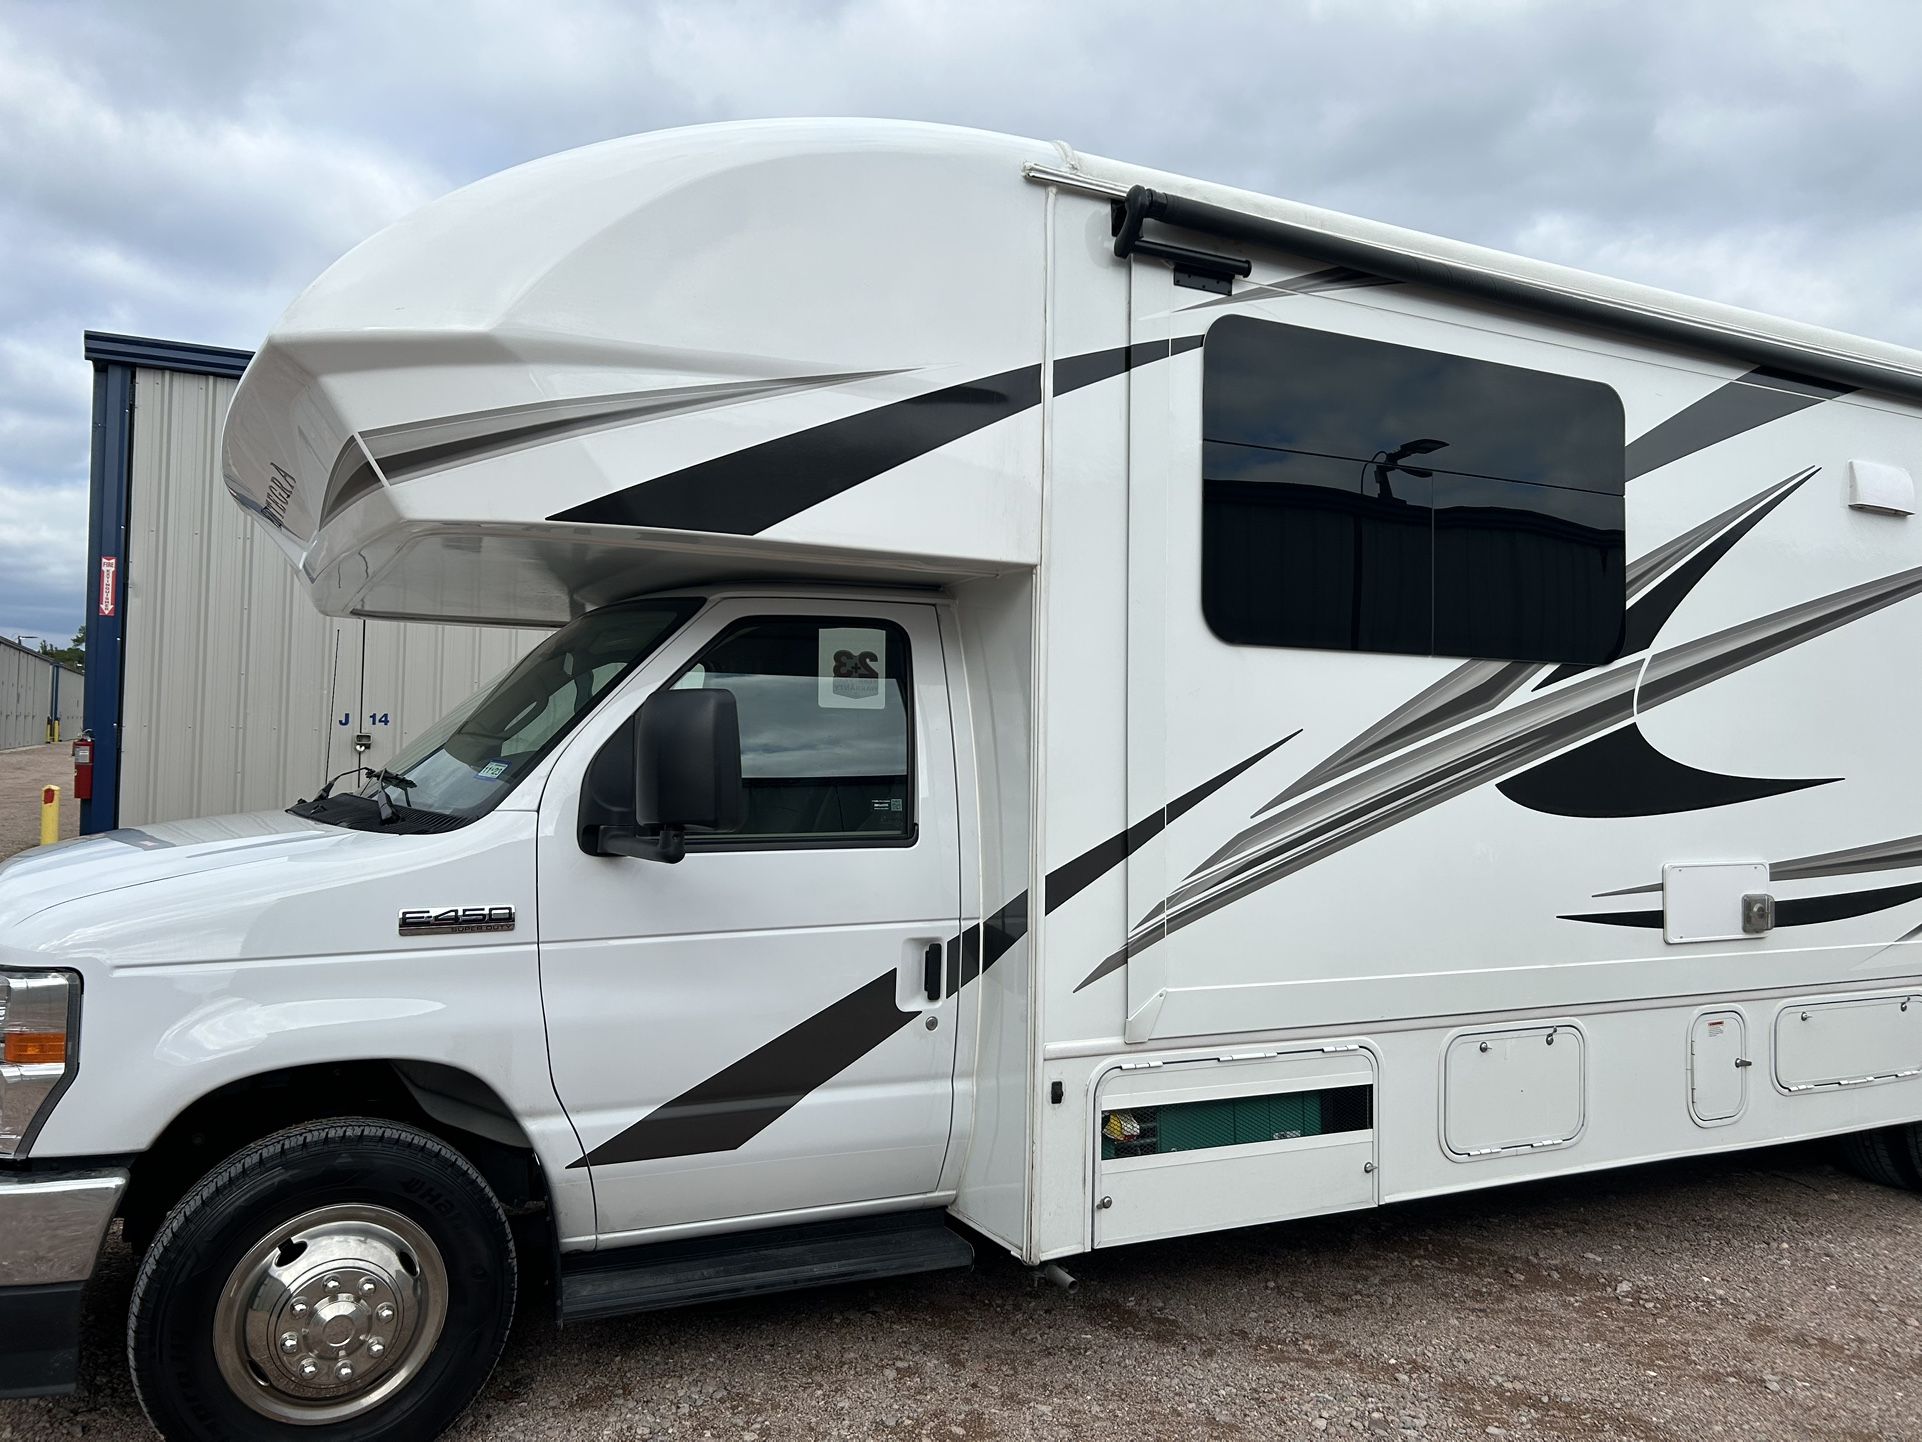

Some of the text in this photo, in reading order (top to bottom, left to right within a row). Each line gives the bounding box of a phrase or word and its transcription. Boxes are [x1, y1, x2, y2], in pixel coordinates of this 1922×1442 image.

[338, 712, 390, 726] J 14
[402, 906, 513, 924] E-450
[451, 924, 513, 934] SUPER DUTY
